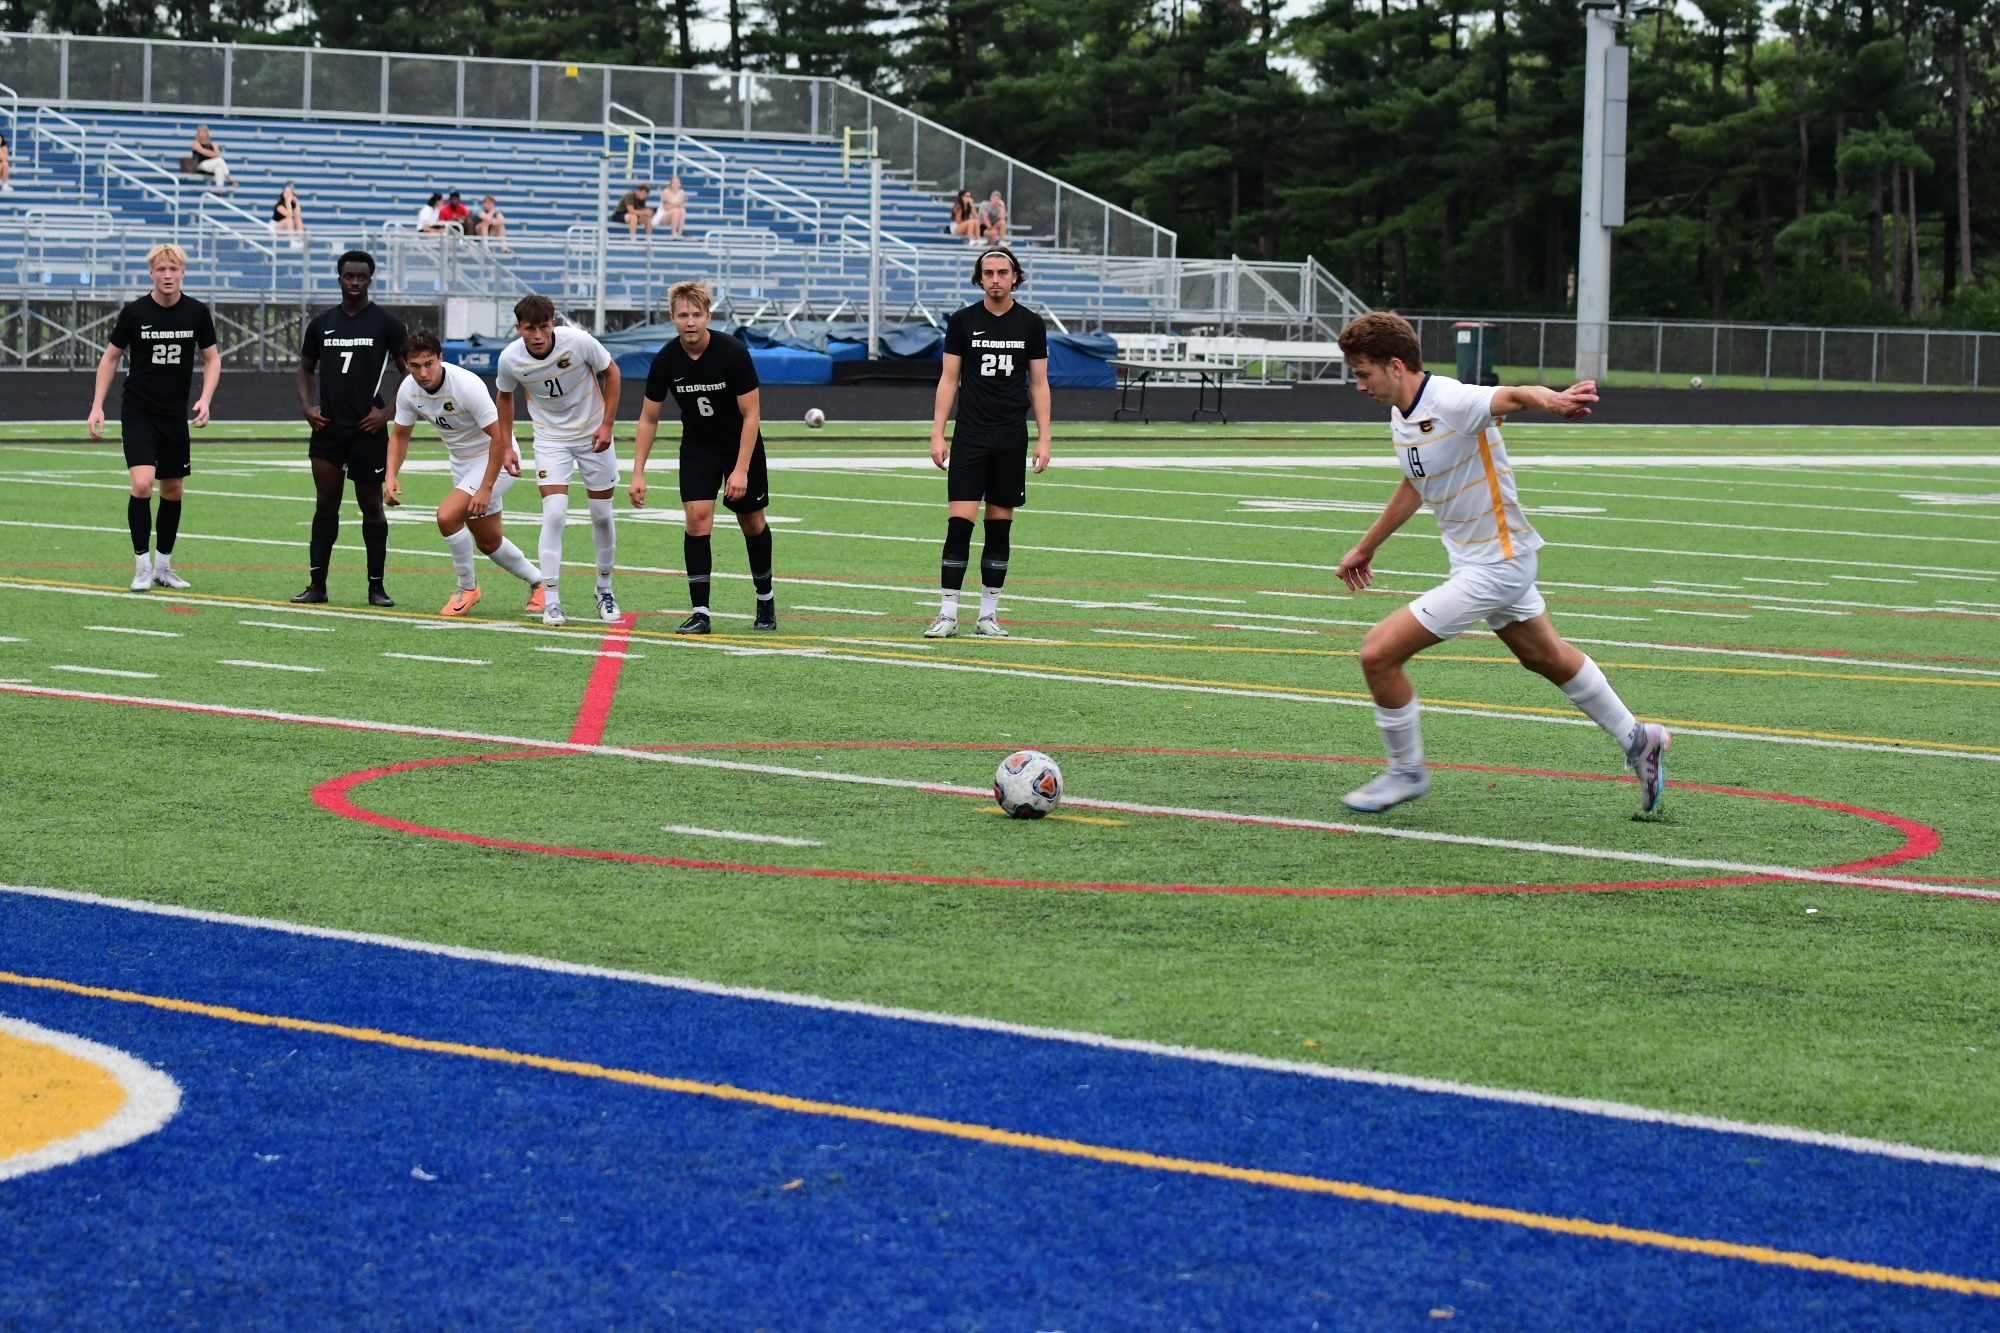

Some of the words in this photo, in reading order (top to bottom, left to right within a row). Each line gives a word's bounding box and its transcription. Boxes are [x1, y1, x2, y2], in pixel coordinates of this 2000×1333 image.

[141, 331, 150, 339] ST.
[151, 331, 175, 339] CLOUD
[175, 330, 194, 338] STATE
[353, 338, 374, 346] STATE
[972, 340, 981, 348] ST.
[982, 340, 1005, 348] CLOUD
[1005, 341, 1026, 349] STATE
[152, 344, 181, 364] 22
[340, 352, 353, 373] 7
[981, 354, 1014, 376] 24
[544, 377, 563, 397] 21
[706, 382, 727, 391] STATE
[697, 397, 714, 417] 6
[1407, 447, 1426, 477] 19
